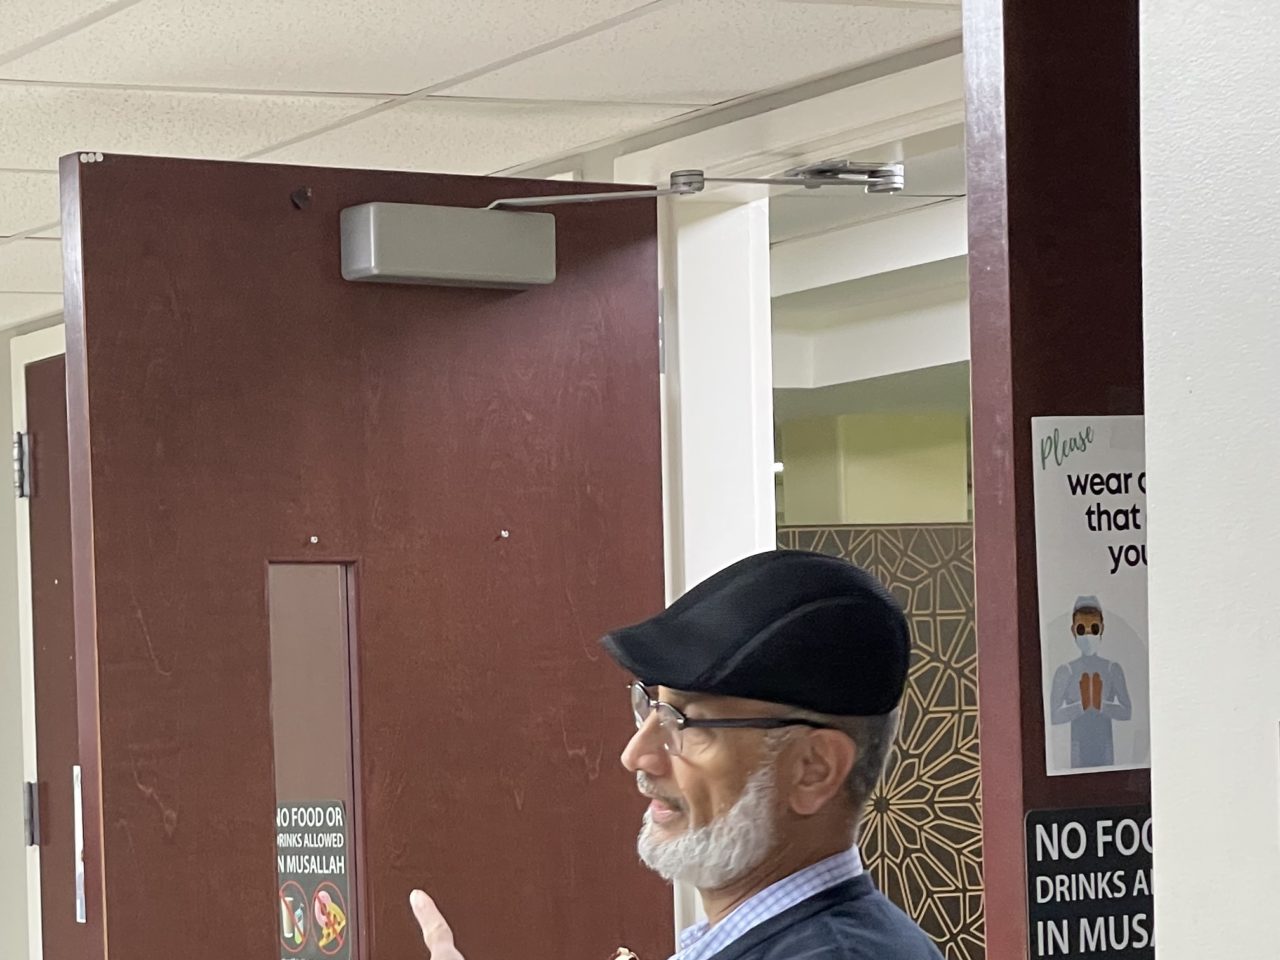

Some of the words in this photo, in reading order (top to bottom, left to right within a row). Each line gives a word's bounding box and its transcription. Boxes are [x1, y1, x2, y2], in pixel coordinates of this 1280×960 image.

[1040, 426, 1094, 470] Please
[1067, 472, 1132, 495] wear
[1085, 503, 1141, 531] that
[291, 807, 324, 827] FOOD
[326, 807, 343, 826] OR
[303, 833, 344, 848] ALLOWED
[1036, 821, 1087, 861] NO
[287, 855, 345, 874] MUSALLAH
[1036, 870, 1126, 904] DRINKS
[1037, 919, 1069, 956] IN
[1080, 913, 1155, 953] MUS
